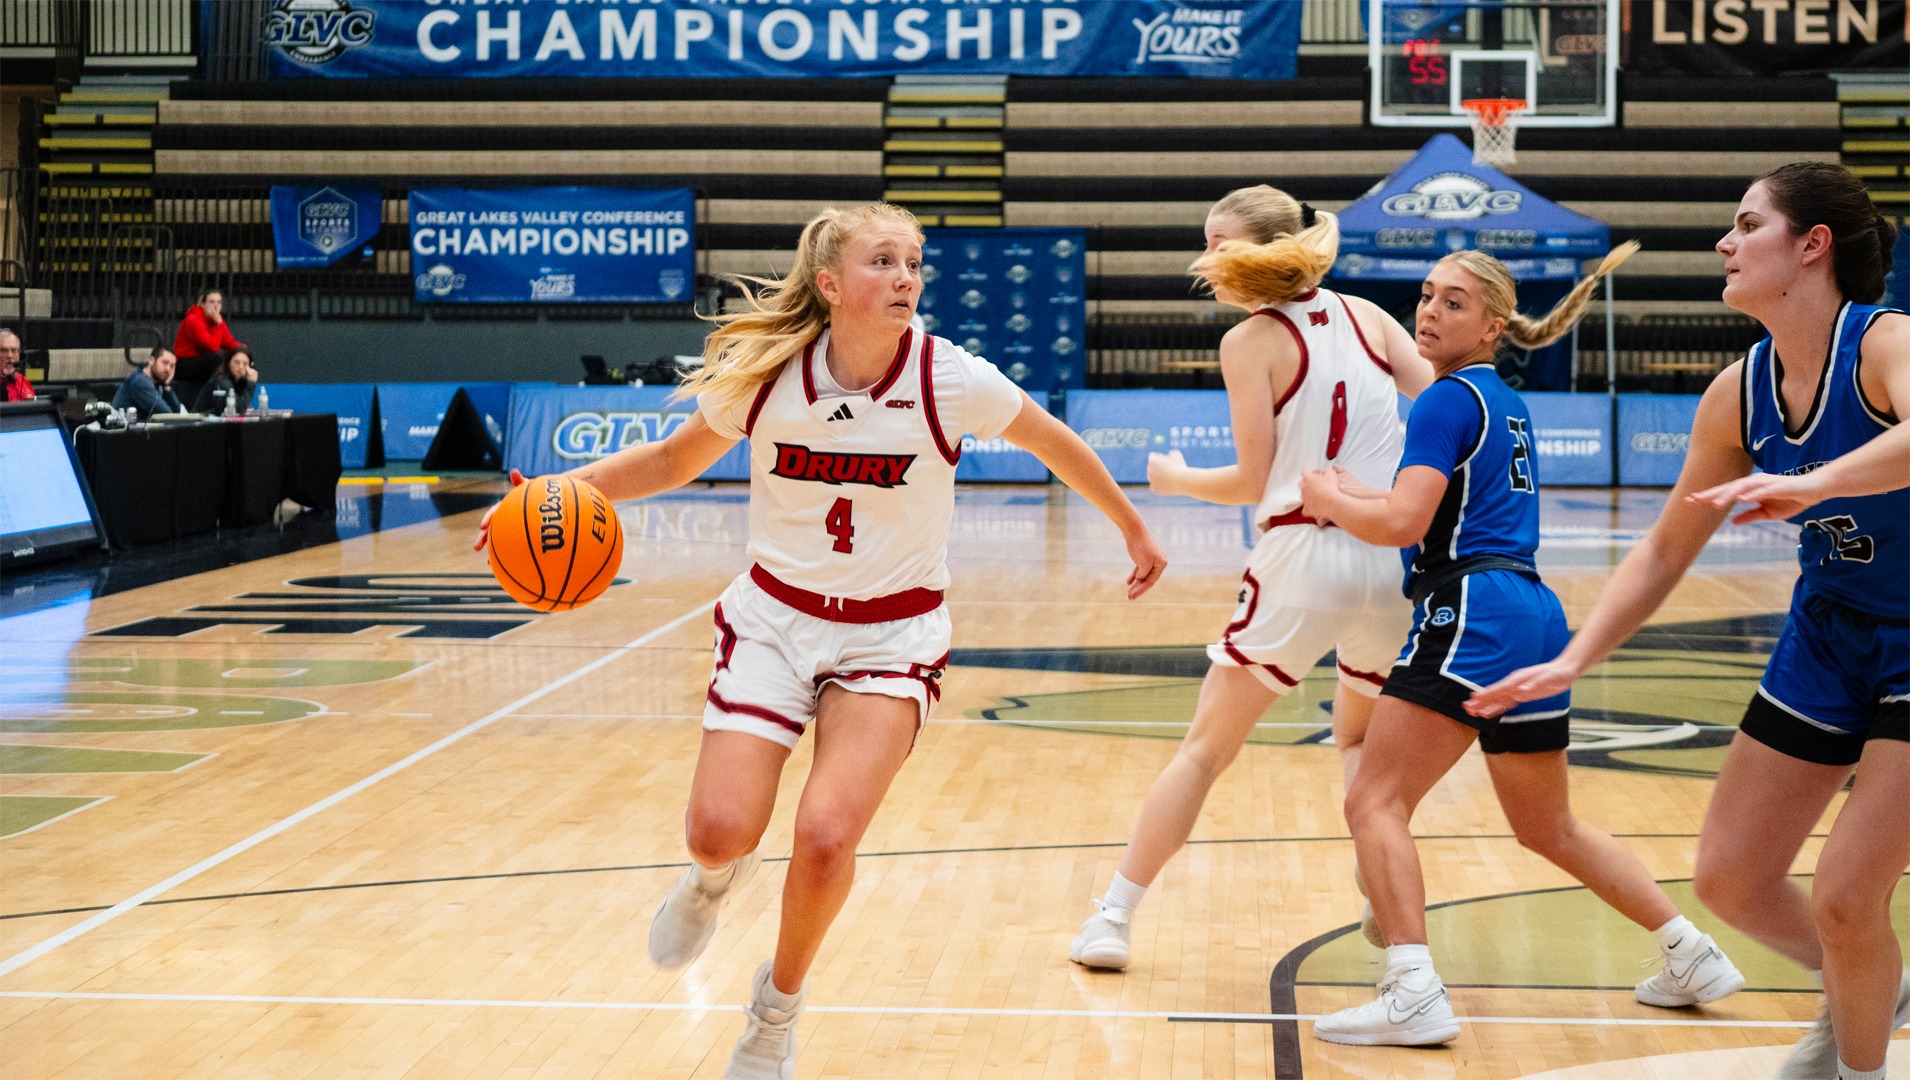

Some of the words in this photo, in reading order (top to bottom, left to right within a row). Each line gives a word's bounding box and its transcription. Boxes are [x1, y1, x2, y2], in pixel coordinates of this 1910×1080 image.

[266, 10, 378, 46] GLVC
[416, 8, 1083, 62] CHAMPIONSHIP
[1172, 8, 1224, 24] MAKE
[1225, 10, 1244, 24] IT
[1652, 0, 1879, 44] LISTEN
[1132, 12, 1242, 63] YOURS
[416, 212, 465, 225] GREAT
[469, 212, 518, 225] LAKES
[522, 212, 578, 225] VALLEY
[582, 211, 685, 225] CONFERENCE
[1382, 190, 1522, 216] GLVC
[413, 228, 689, 256] CHAMPIONSHIP
[1080, 427, 1150, 449] GLVC
[769, 441, 918, 488] DRURY
[538, 479, 565, 554] Wilson
[825, 496, 855, 554] 4
